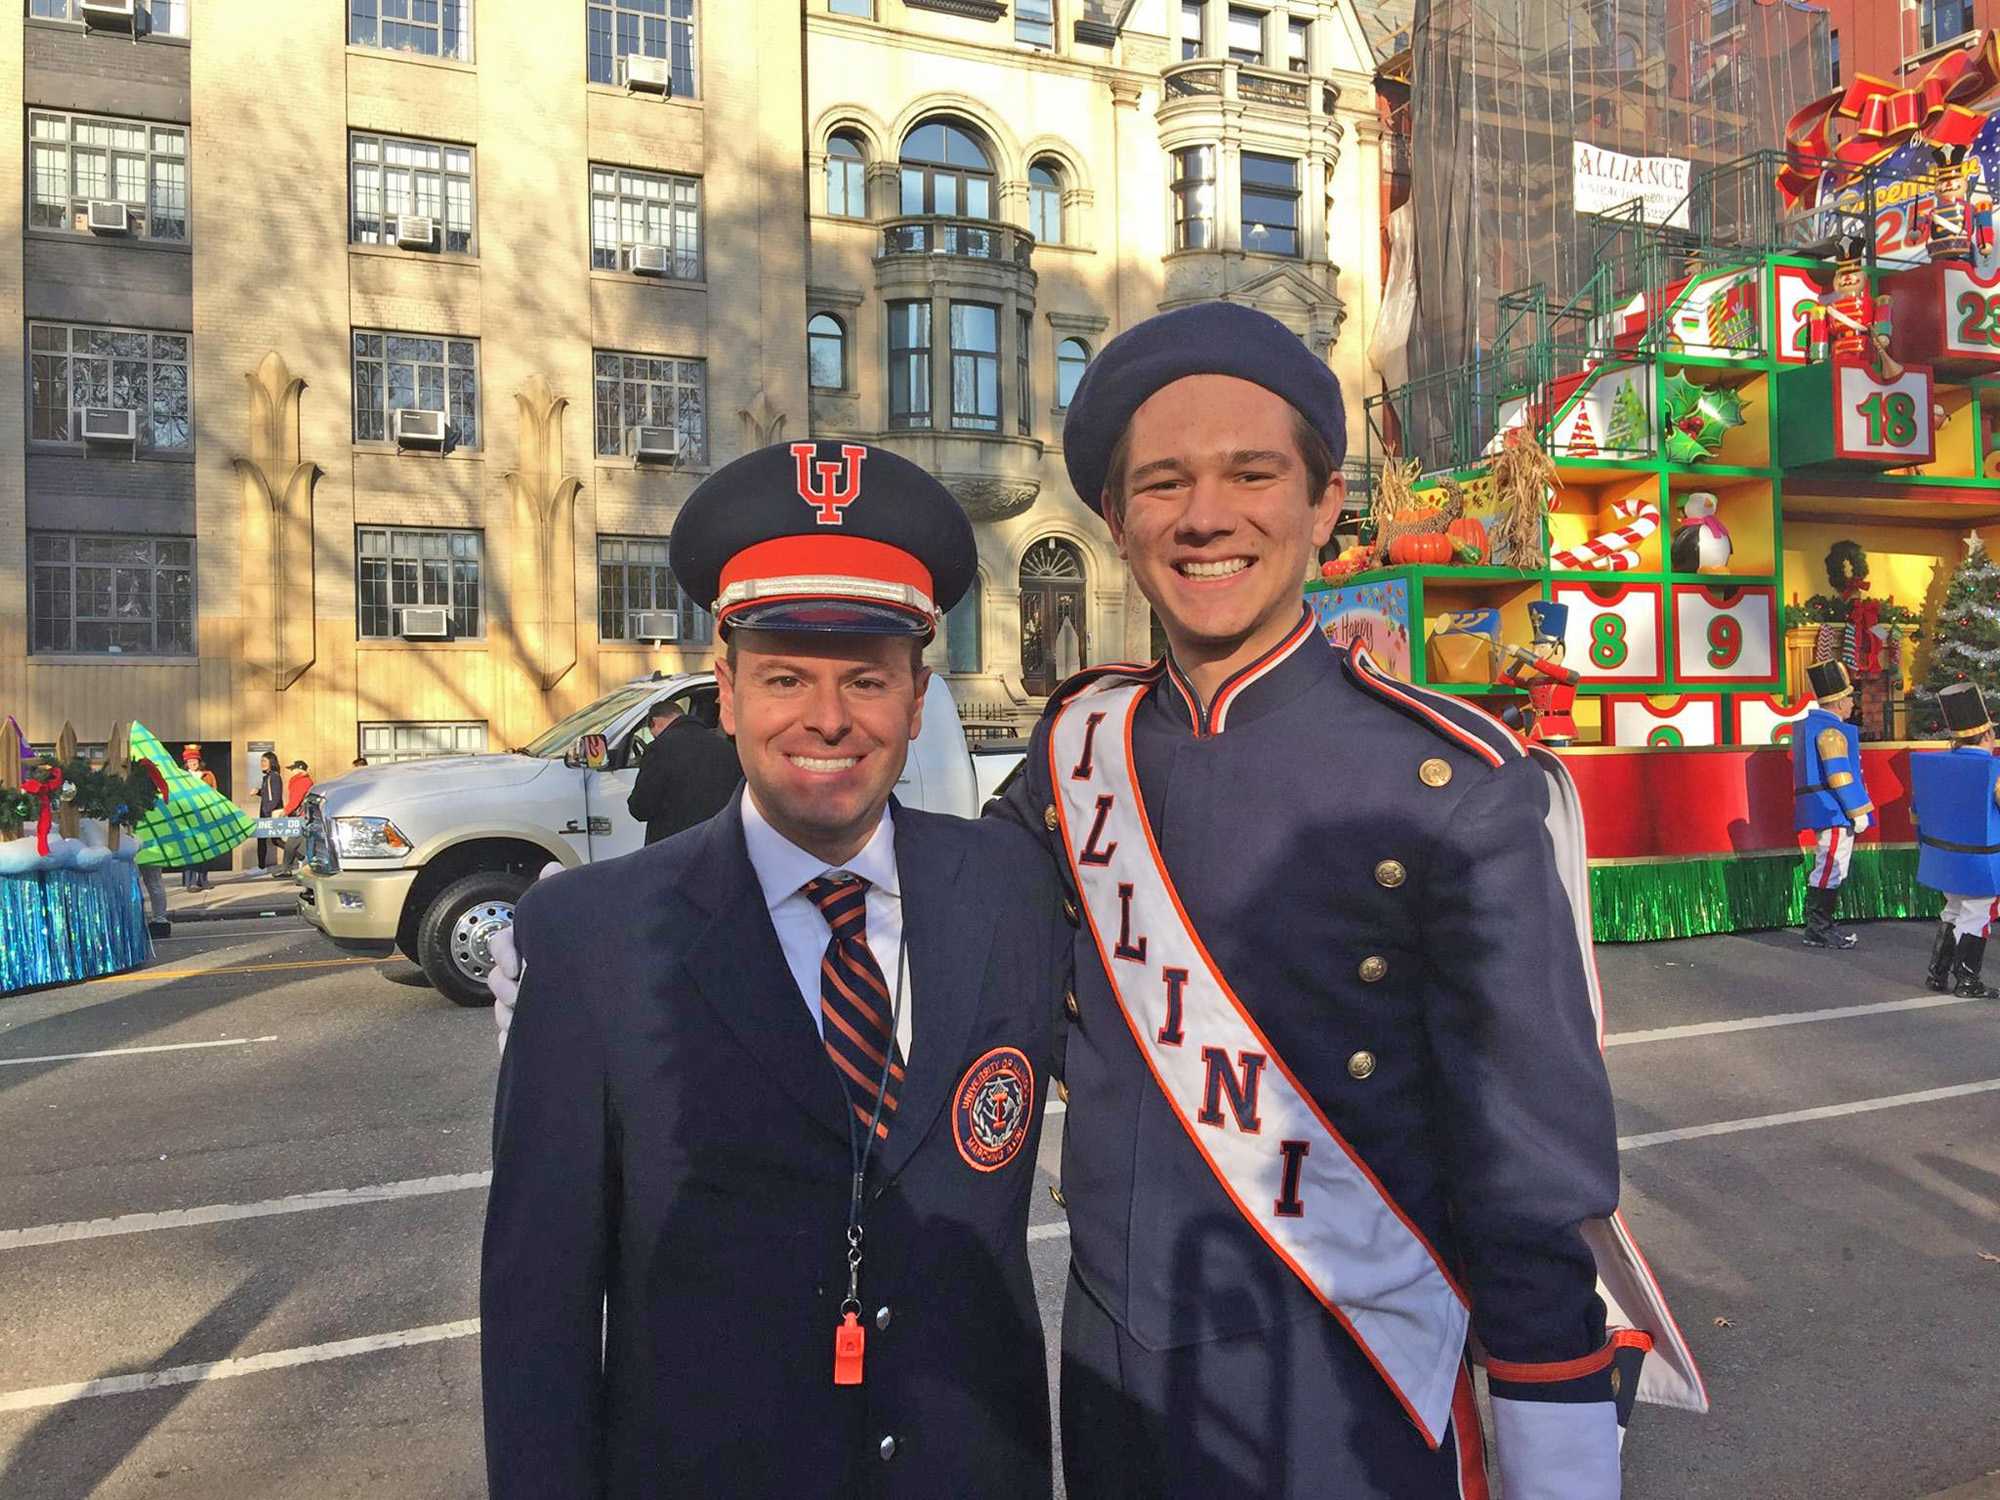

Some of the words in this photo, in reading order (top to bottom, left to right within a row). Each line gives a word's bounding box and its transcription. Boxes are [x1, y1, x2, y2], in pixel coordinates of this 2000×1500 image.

[1579, 148, 1685, 191] ALLIANCE
[1874, 198, 1936, 255] 25
[1856, 392, 1917, 448] 18
[1589, 612, 1628, 669] 8
[1707, 614, 1742, 670] 9
[268, 828, 300, 836] NYPD
[1070, 711, 1311, 1219] ILLINI
